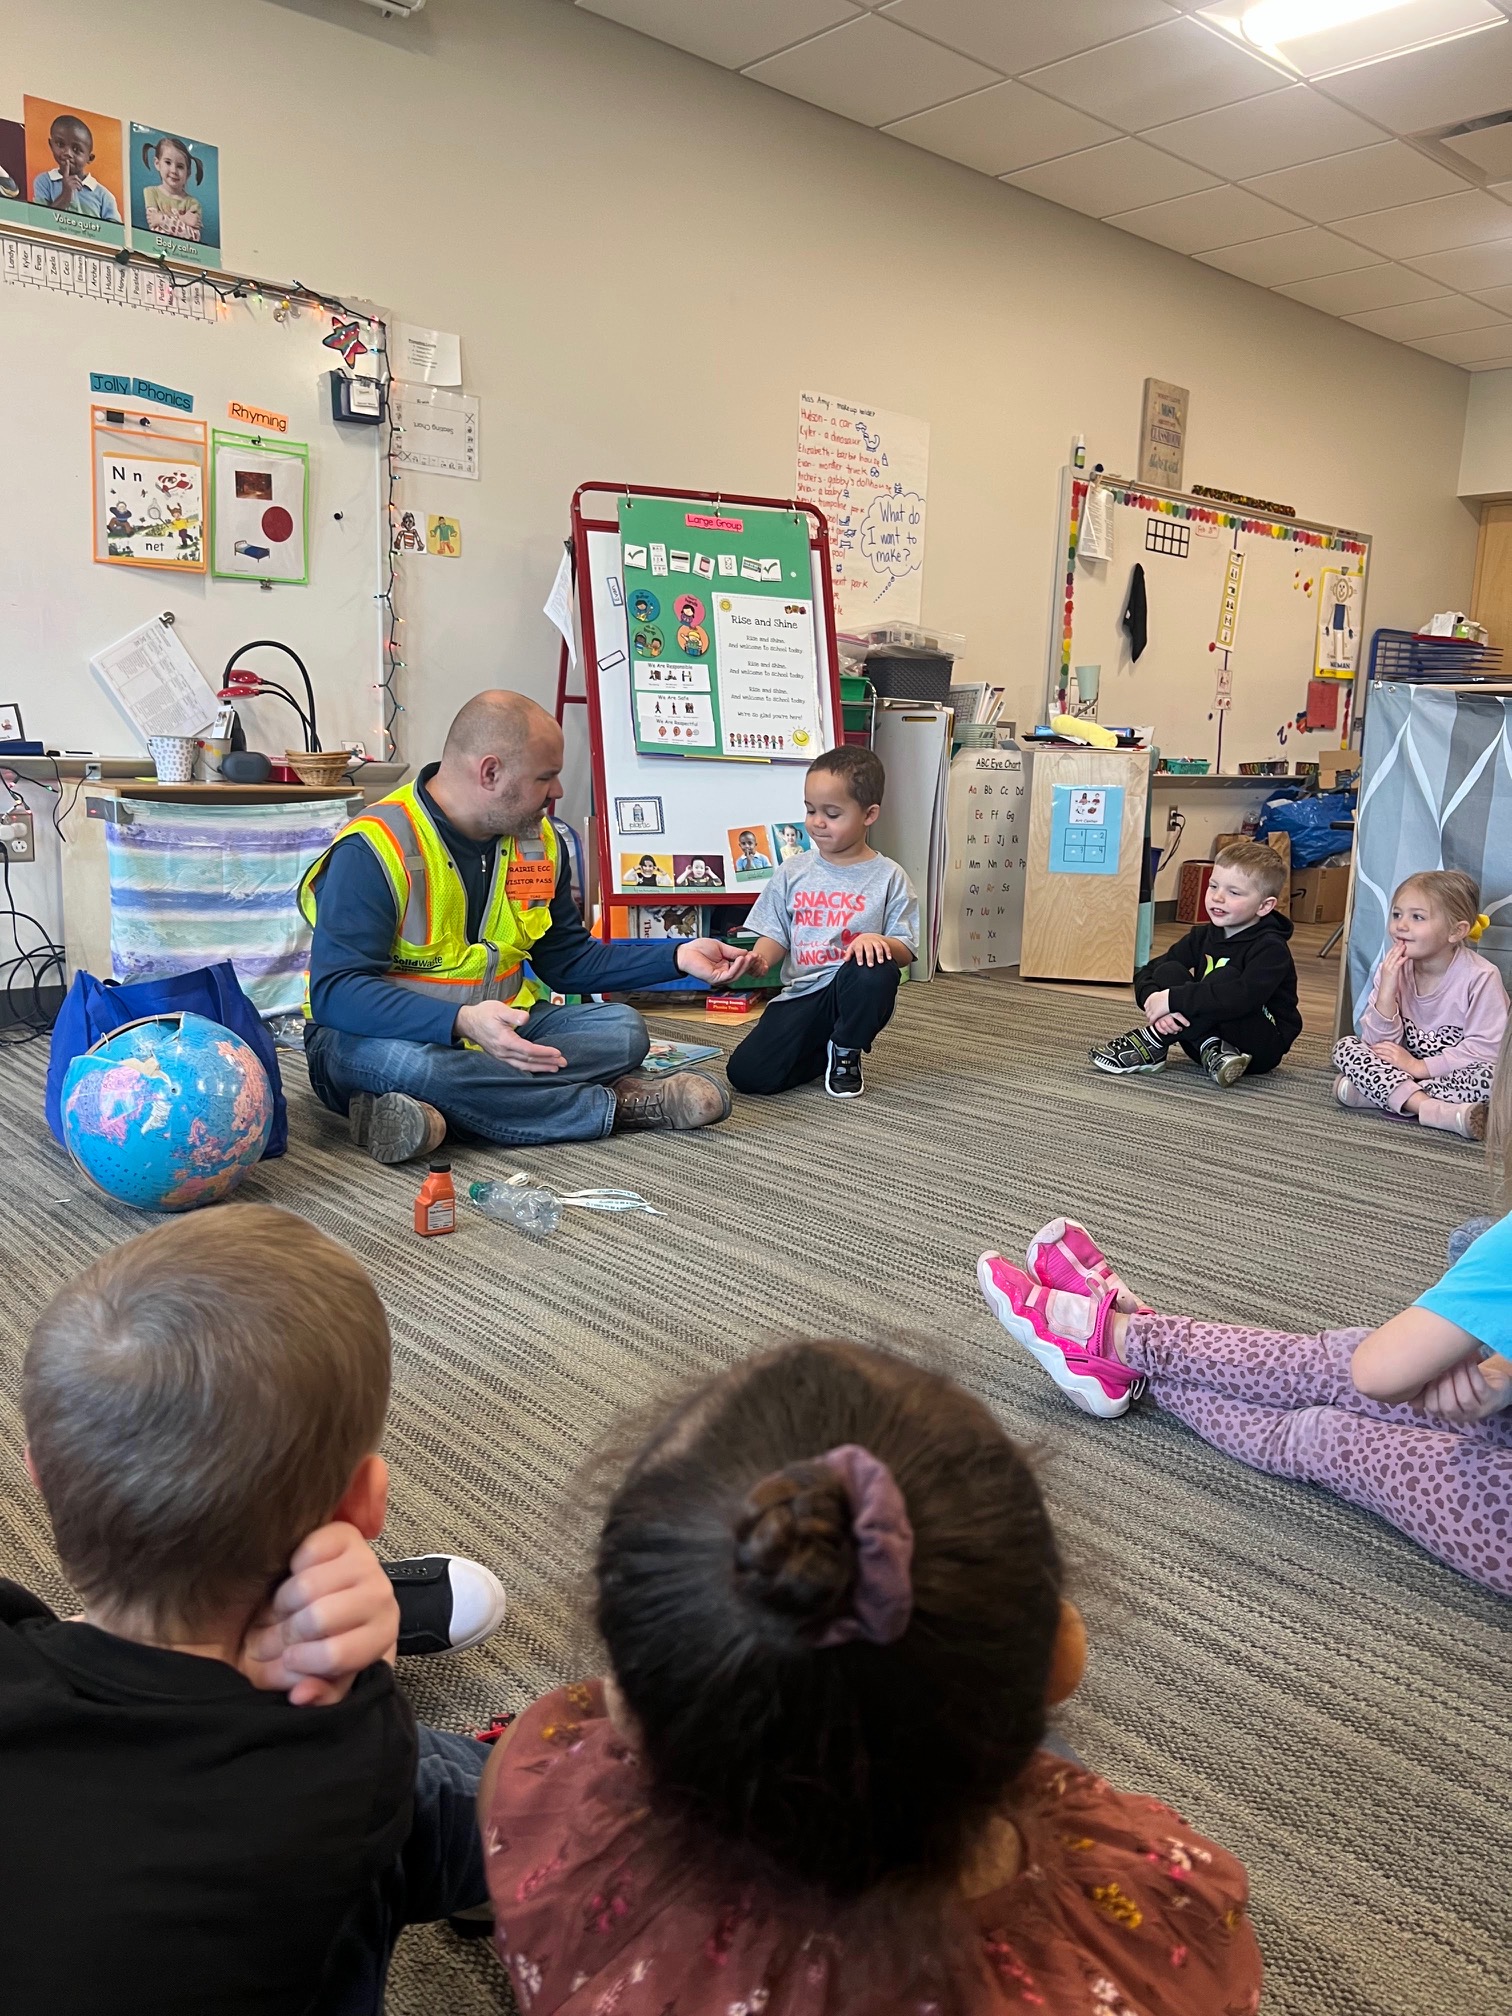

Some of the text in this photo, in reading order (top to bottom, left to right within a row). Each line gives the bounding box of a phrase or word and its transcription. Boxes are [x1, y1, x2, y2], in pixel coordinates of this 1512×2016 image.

[53, 213, 76, 226] Voice
[79, 221, 100, 232] quiet
[156, 236, 177, 251] Body
[178, 244, 198, 255] calm
[8, 244, 16, 269] Landyn
[22, 250, 30, 268] Kyler
[94, 375, 191, 410] Jolly Phonics
[232, 403, 287, 432] Rhyming
[839, 420, 852, 428] car
[413, 422, 454, 434] Seating Chart
[831, 431, 861, 445] dinosaur
[836, 449, 856, 460] barbie
[860, 452, 880, 468] house
[112, 466, 142, 482] N n
[818, 460, 842, 470] monster
[846, 464, 868, 475] truck
[856, 479, 892, 494] dollhouse
[824, 487, 842, 501] baby
[880, 501, 920, 524] What do
[687, 514, 742, 532] Large Group
[867, 526, 917, 546] I want to
[146, 542, 164, 552] net
[851, 580, 868, 590] park
[731, 615, 798, 629] Rise and Shine
[976, 758, 1022, 770] ABC Eye Chart
[968, 785, 1024, 796] Aa Bb Cc Dd
[975, 810, 1015, 822] Ee Ff Gg
[967, 834, 1019, 846] Hh Ii Jj Kk
[1100, 832, 1104, 840] 2
[968, 860, 980, 869] Mm
[988, 860, 998, 868] Nn
[1004, 859, 1012, 868] Oo
[1019, 858, 1026, 870] Pp
[506, 878, 534, 886] VISITOR
[970, 883, 1010, 895] Qq Rr Ss
[793, 890, 866, 912] SNACKS
[966, 906, 1005, 916] Tt Uu Vv
[794, 910, 854, 928] ARE MY
[988, 930, 996, 938] Xx
[988, 954, 996, 962] Zz
